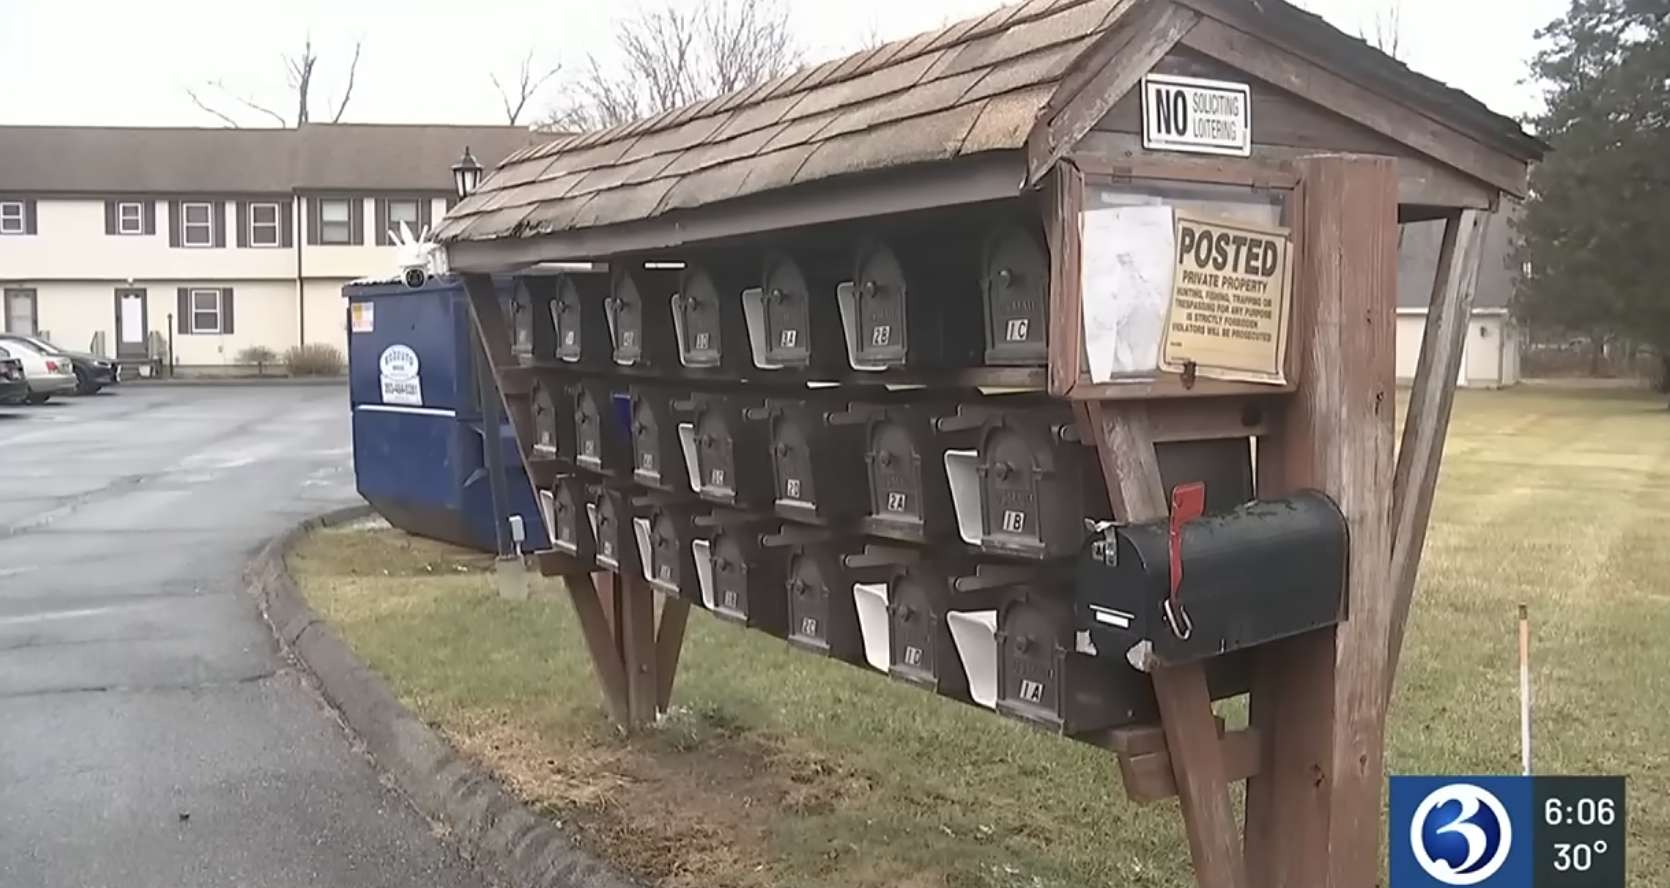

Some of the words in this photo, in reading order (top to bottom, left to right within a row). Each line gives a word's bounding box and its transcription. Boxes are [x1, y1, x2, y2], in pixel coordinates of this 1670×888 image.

[1156, 88, 1188, 137] NO
[1192, 92, 1239, 117] SOLICITING
[1192, 117, 1237, 141] LOITERING
[1179, 226, 1278, 278] POSTED
[1182, 270, 1220, 288] PRIVATE
[1221, 276, 1268, 294] PROPERTY
[1175, 298, 1216, 312] TRESPASSING
[1217, 303, 1230, 314] FOR
[1231, 305, 1244, 315] ANY
[1244, 306, 1272, 320] PURPOSE
[1009, 320, 1027, 339] 1C
[1194, 312, 1222, 325] STRICTLY
[1224, 316, 1258, 329] FORBIDDEN
[1172, 322, 1205, 335] VIOLATORS
[1206, 326, 1220, 337] WILL
[1221, 328, 1230, 338] BE
[1231, 329, 1272, 342] PROSECUTED
[889, 493, 905, 510] 2A
[1005, 512, 1022, 530] 1B
[1023, 681, 1041, 700] 1A
